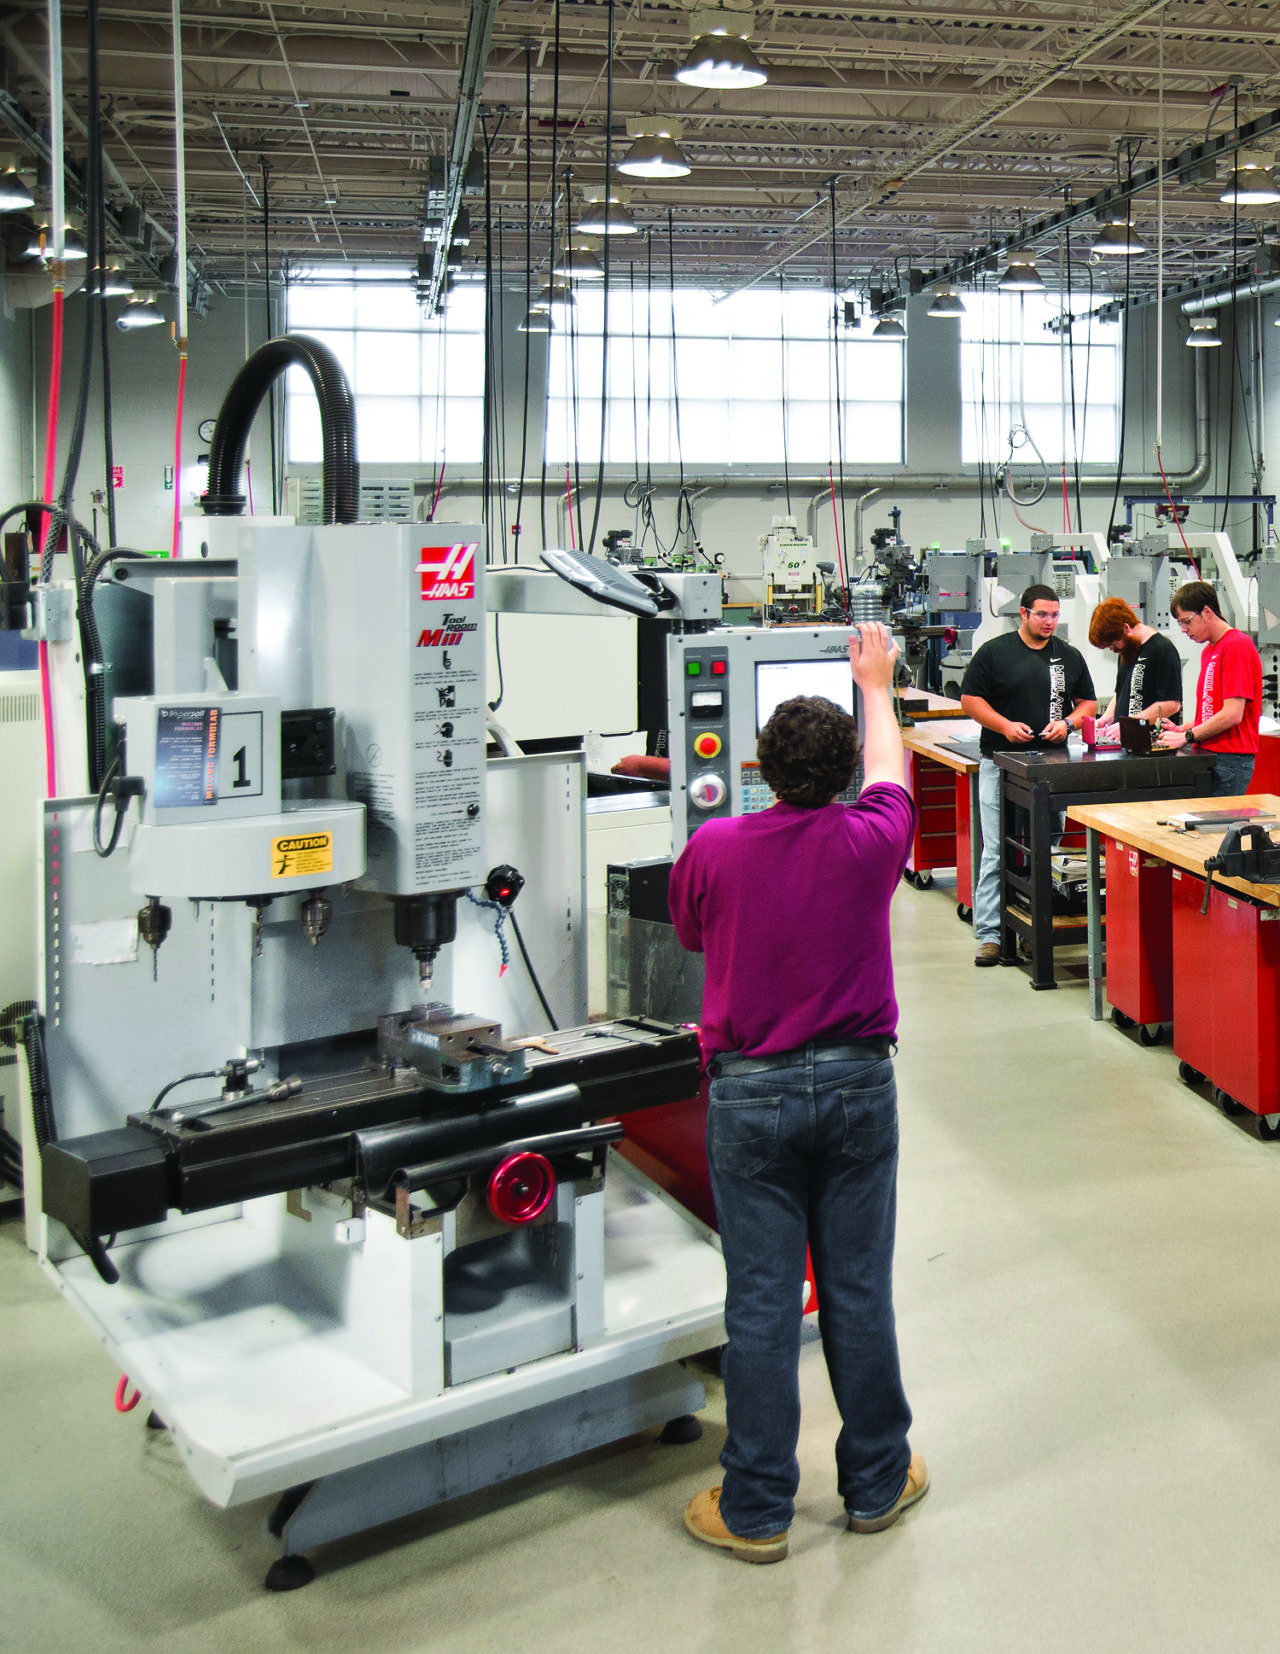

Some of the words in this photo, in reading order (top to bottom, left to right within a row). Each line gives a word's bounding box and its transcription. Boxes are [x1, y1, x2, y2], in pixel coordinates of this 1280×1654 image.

[420, 582, 475, 598] HAAS
[819, 644, 850, 654] HAAS
[1054, 664, 1066, 721] MIDLAND
[1132, 663, 1146, 716] MIDLAN
[1203, 661, 1216, 721] MIDLAN
[207, 709, 218, 758] FORMULAS
[233, 745, 251, 788] 1
[279, 837, 328, 851] CAUTION
